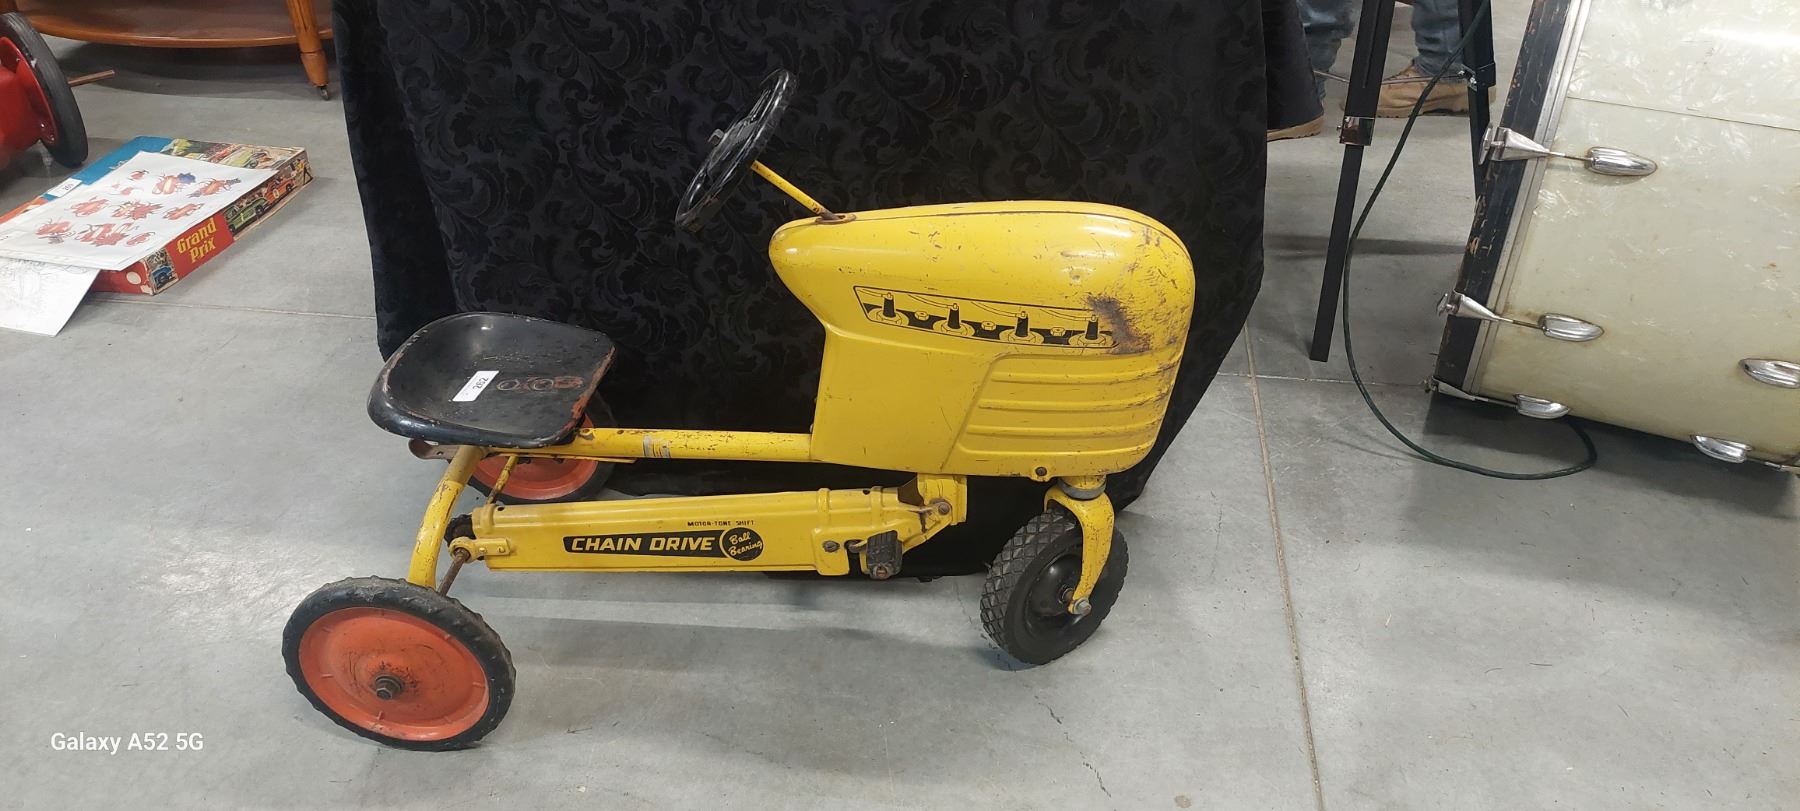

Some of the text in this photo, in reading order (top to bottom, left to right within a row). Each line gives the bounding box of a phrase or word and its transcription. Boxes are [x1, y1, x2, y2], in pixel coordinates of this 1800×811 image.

[176, 217, 217, 254] Grand
[190, 237, 216, 264] Prix
[571, 536, 716, 551] CHAIN DRIVE
[728, 531, 751, 545] Ball
[728, 540, 762, 556] Bearing
